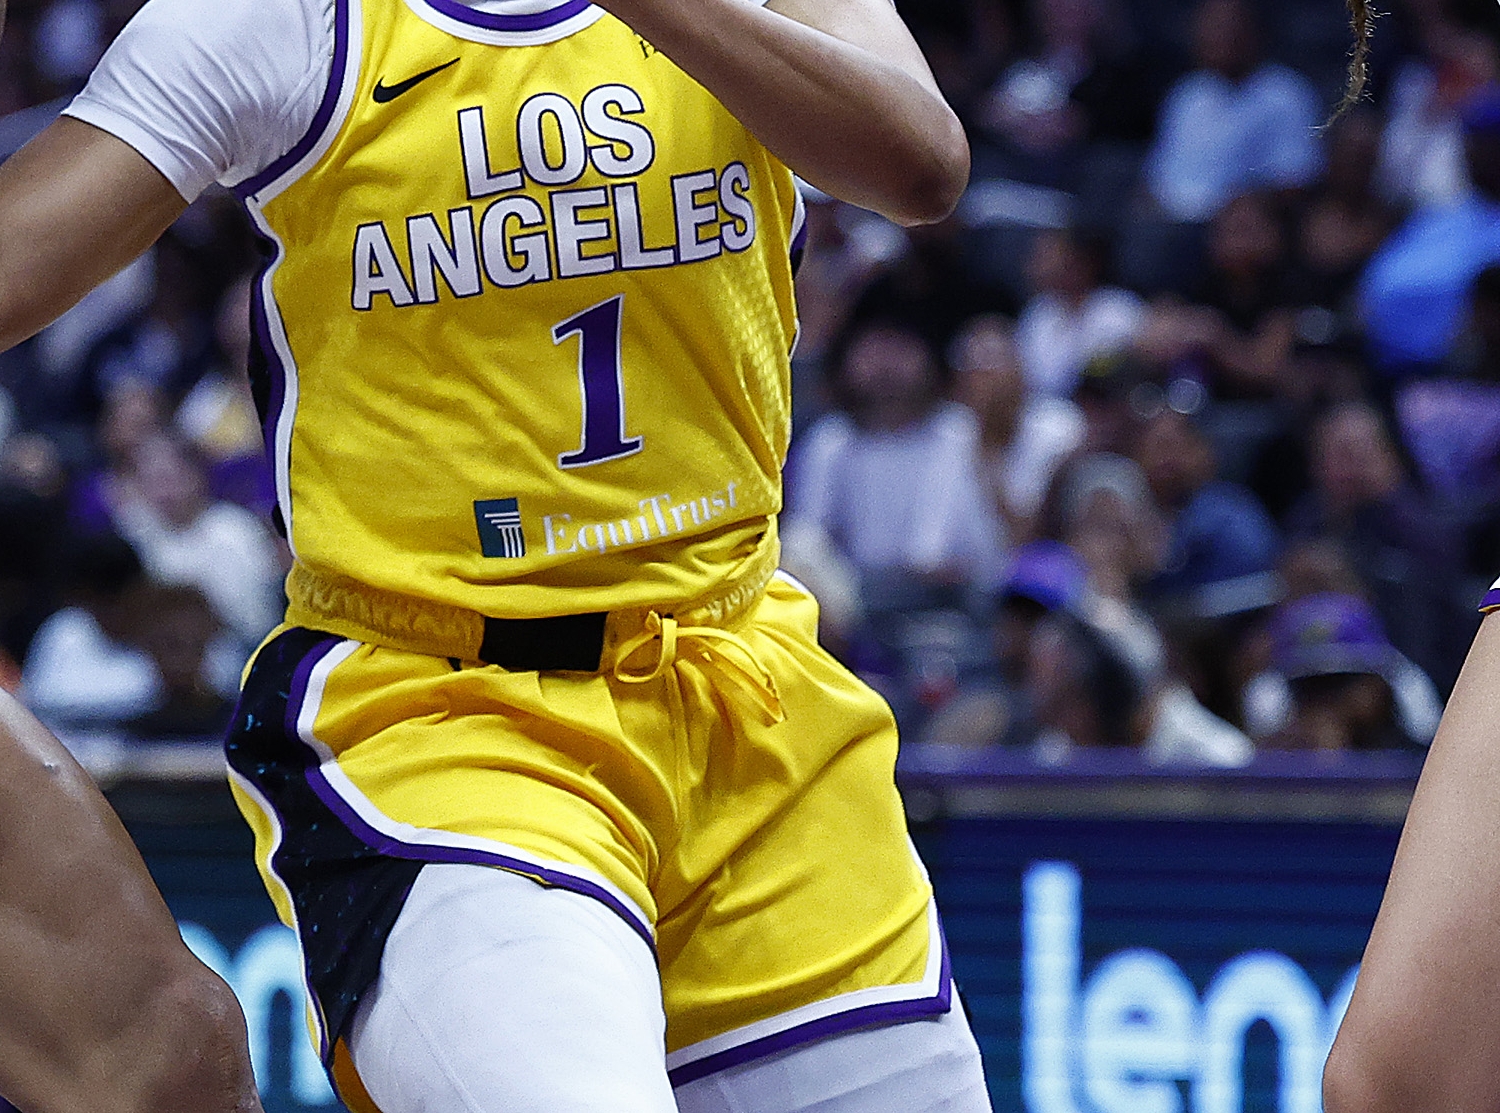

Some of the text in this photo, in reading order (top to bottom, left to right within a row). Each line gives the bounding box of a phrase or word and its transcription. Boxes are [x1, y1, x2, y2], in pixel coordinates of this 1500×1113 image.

[457, 83, 656, 199] LOS
[350, 161, 757, 310] ANGELES
[551, 292, 644, 469] 1
[543, 480, 739, 556] EquiTrust
[1021, 858, 1364, 1113] len
